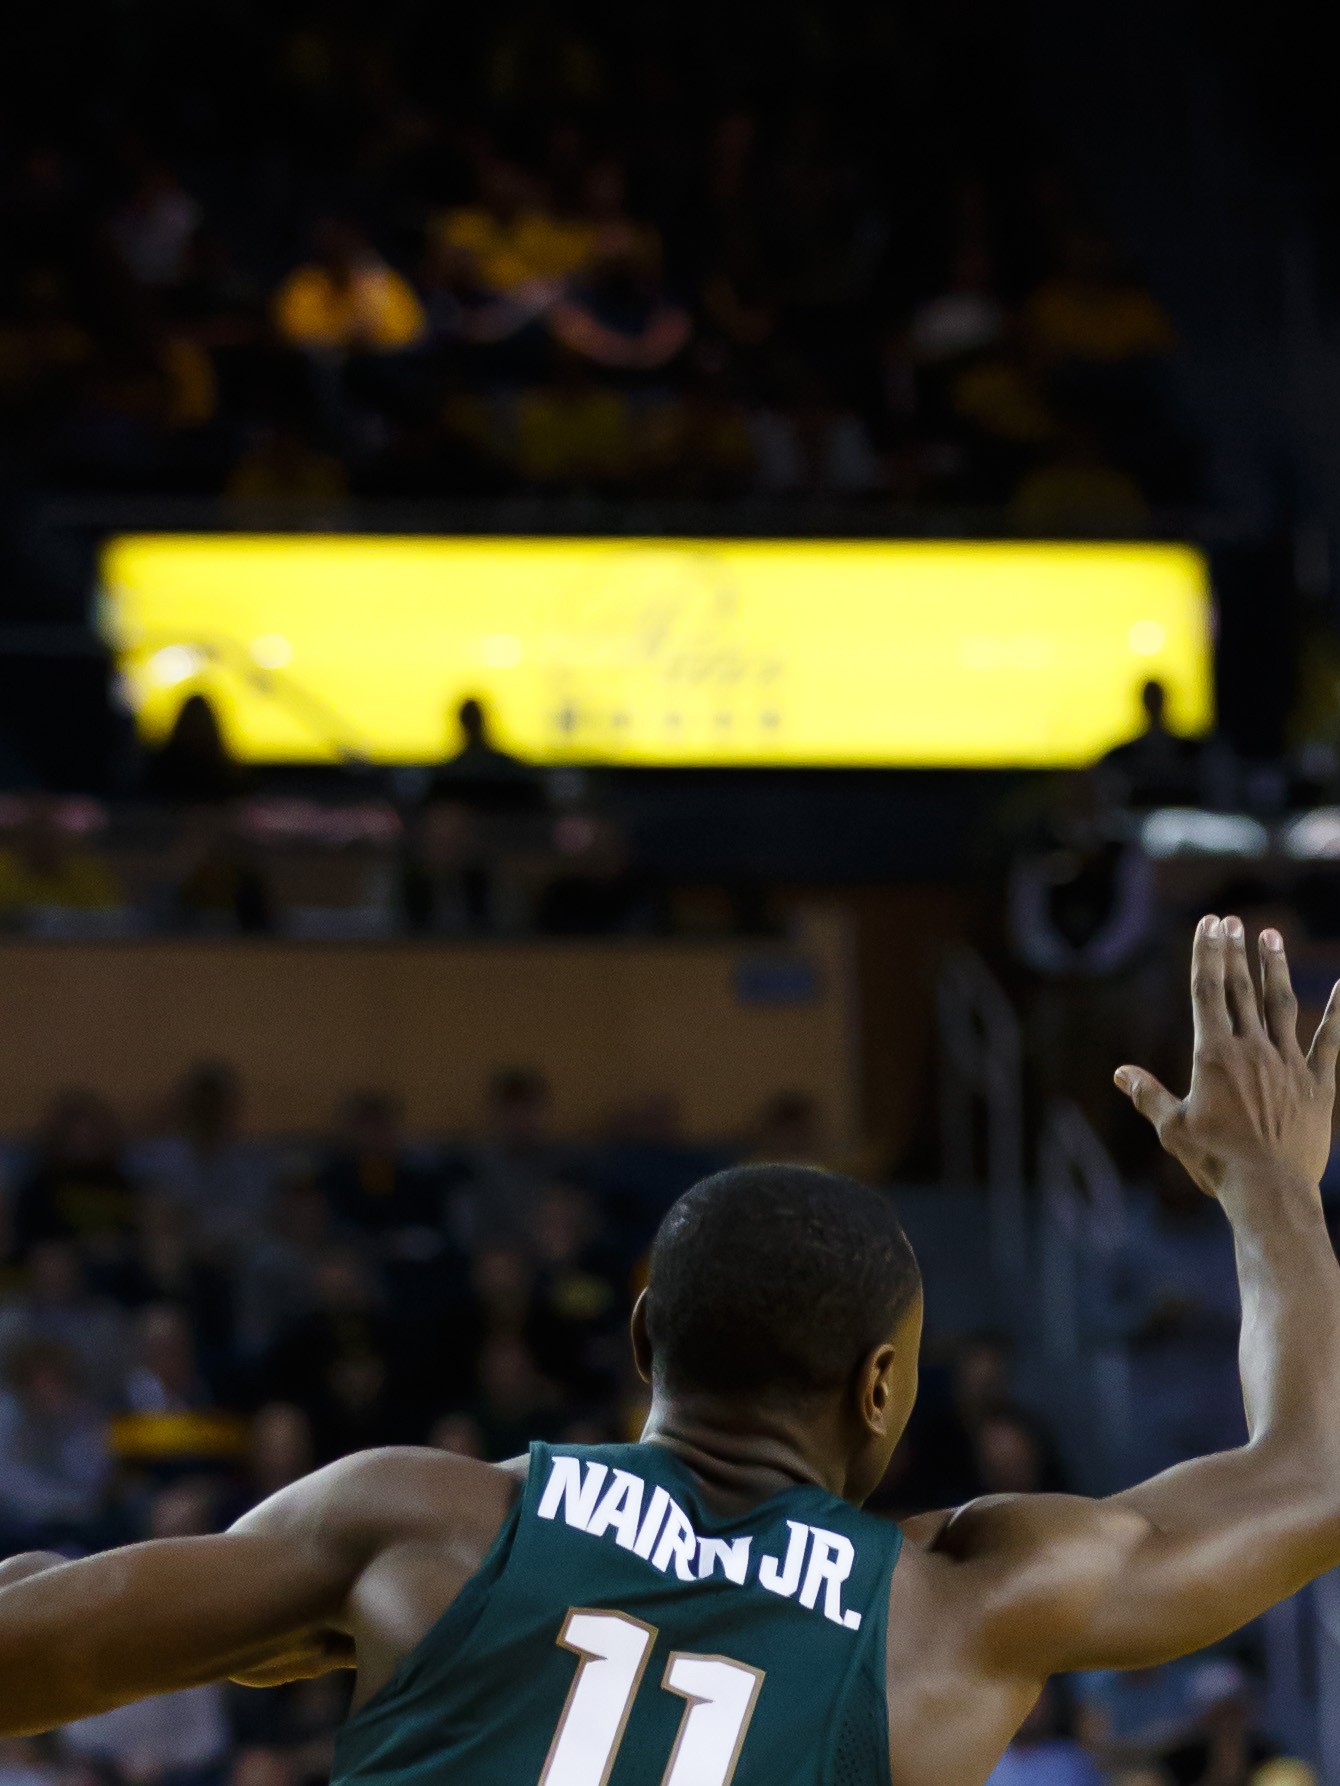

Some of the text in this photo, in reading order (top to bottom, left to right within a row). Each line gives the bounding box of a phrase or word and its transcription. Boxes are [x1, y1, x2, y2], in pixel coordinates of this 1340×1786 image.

[537, 1456, 862, 1631] NAIRN JR.
[538, 1606, 766, 1786] 11
